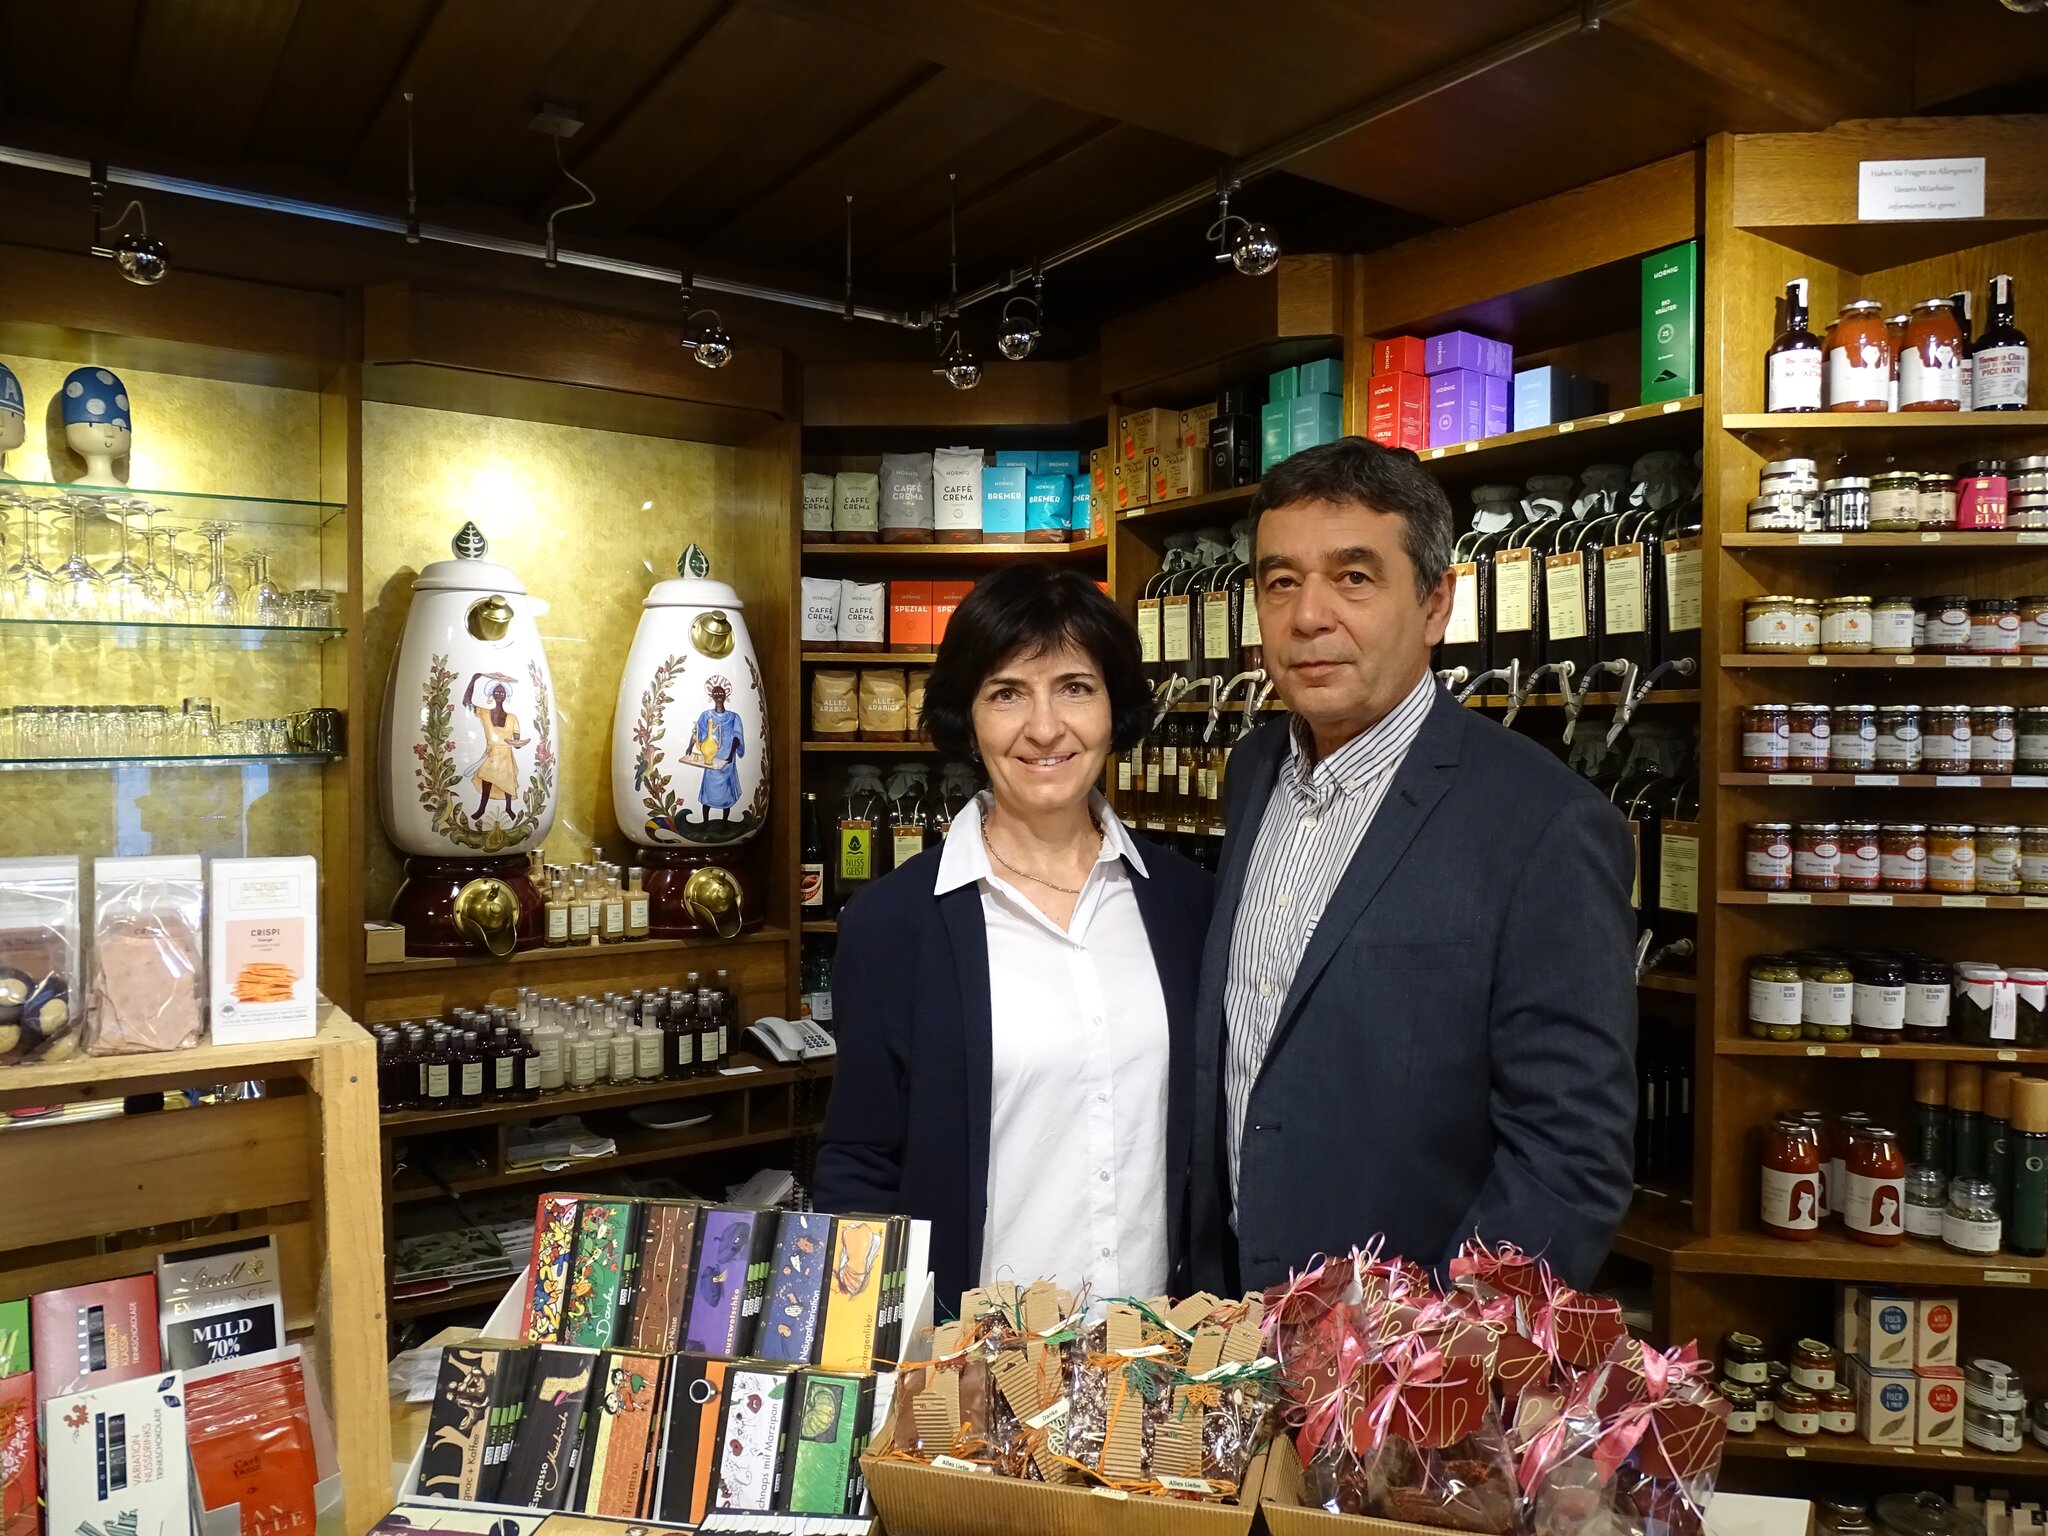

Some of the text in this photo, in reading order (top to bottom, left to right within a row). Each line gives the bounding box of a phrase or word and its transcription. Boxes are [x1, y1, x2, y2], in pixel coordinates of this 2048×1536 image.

[1654, 265, 1679, 280] HORNIG
[1435, 384, 1456, 394] HORNIG
[942, 494, 974, 502] CREMA
[987, 492, 1022, 500] BREMER
[1029, 494, 1060, 504] BREMER
[895, 605, 928, 613] SPEZIAL
[847, 613, 875, 621] CREMA
[820, 705, 851, 713] ARABICA
[868, 704, 900, 712] ARABICA
[846, 858, 865, 867] NUSS
[846, 867, 864, 876] GEIST
[250, 928, 280, 937] CRISPI
[192, 1318, 253, 1343] MILD
[798, 1290, 820, 1361] NougatVariation
[207, 1337, 240, 1359] 70%
[1042, 1408, 1059, 1421] Danke
[765, 1403, 779, 1452] Marzipan
[467, 1434, 480, 1465] Kaffee
[131, 1434, 141, 1487] VARIATION
[762, 1453, 774, 1470] mit
[942, 1459, 970, 1471] Alles Liebe
[528, 1462, 548, 1508] Espresso
[622, 1463, 639, 1514] Tiramisu
